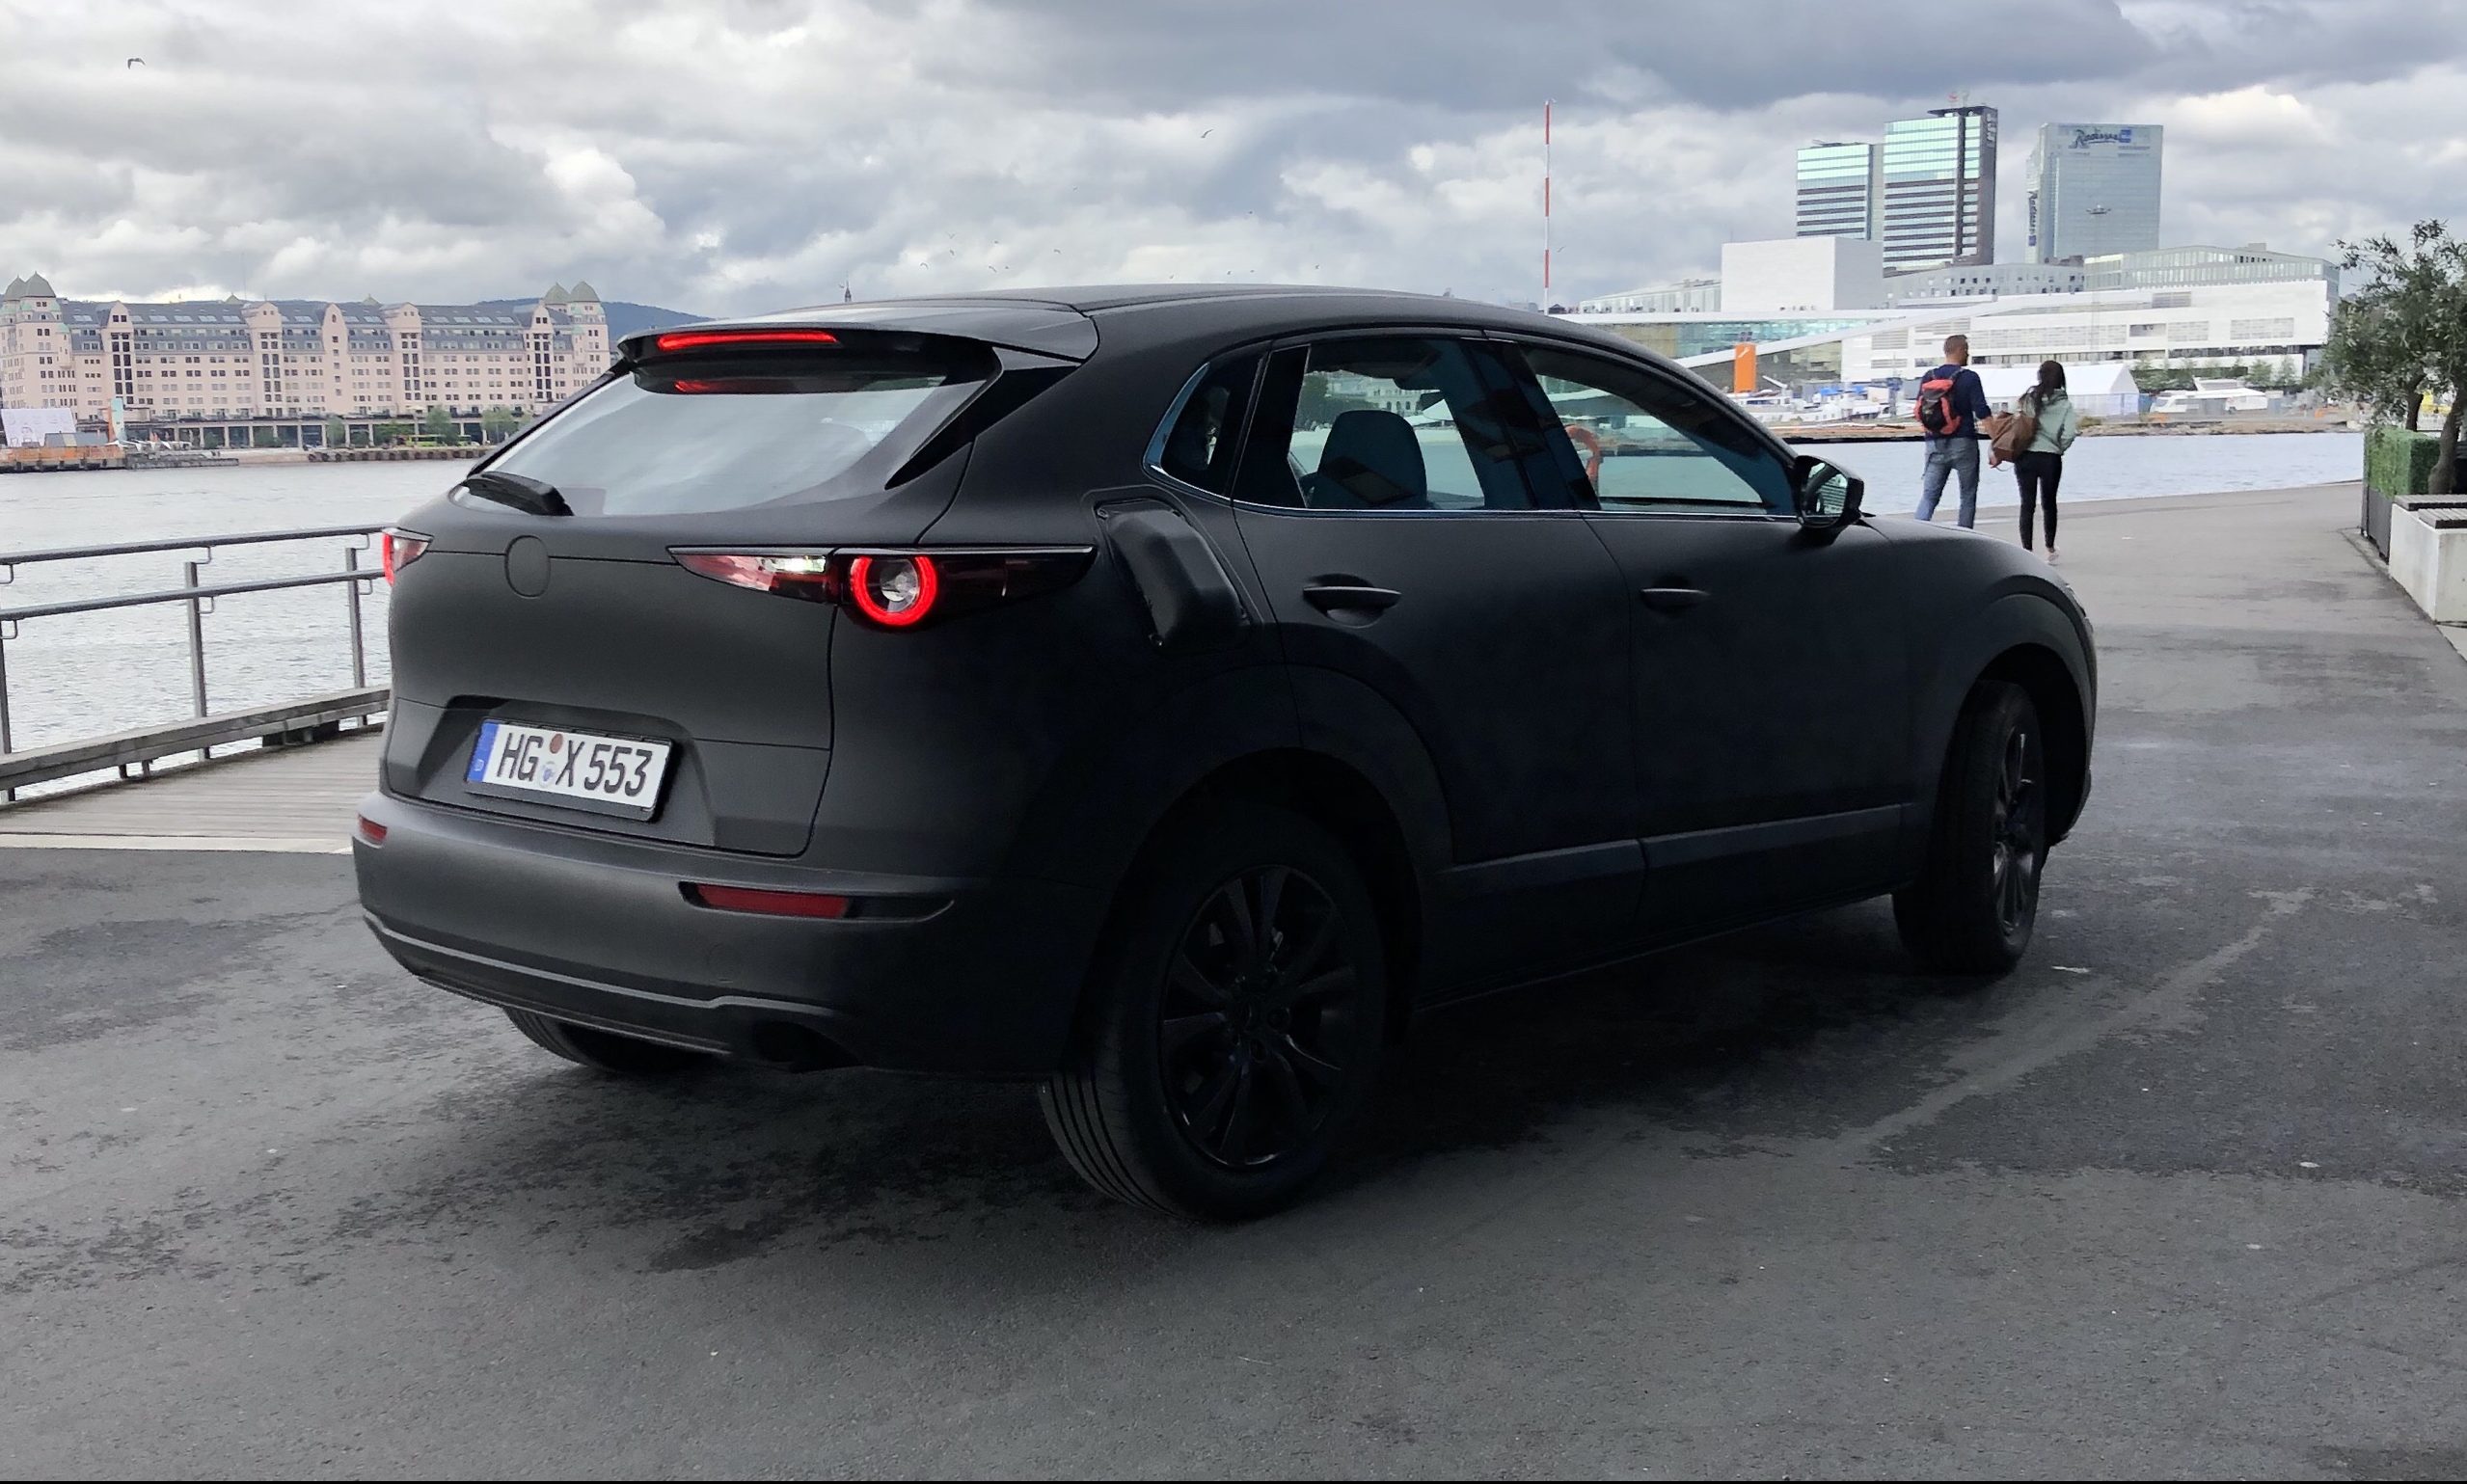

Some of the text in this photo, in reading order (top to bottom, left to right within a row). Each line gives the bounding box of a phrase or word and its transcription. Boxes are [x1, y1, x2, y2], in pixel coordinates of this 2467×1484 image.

[497, 733, 653, 797] HG X 553
